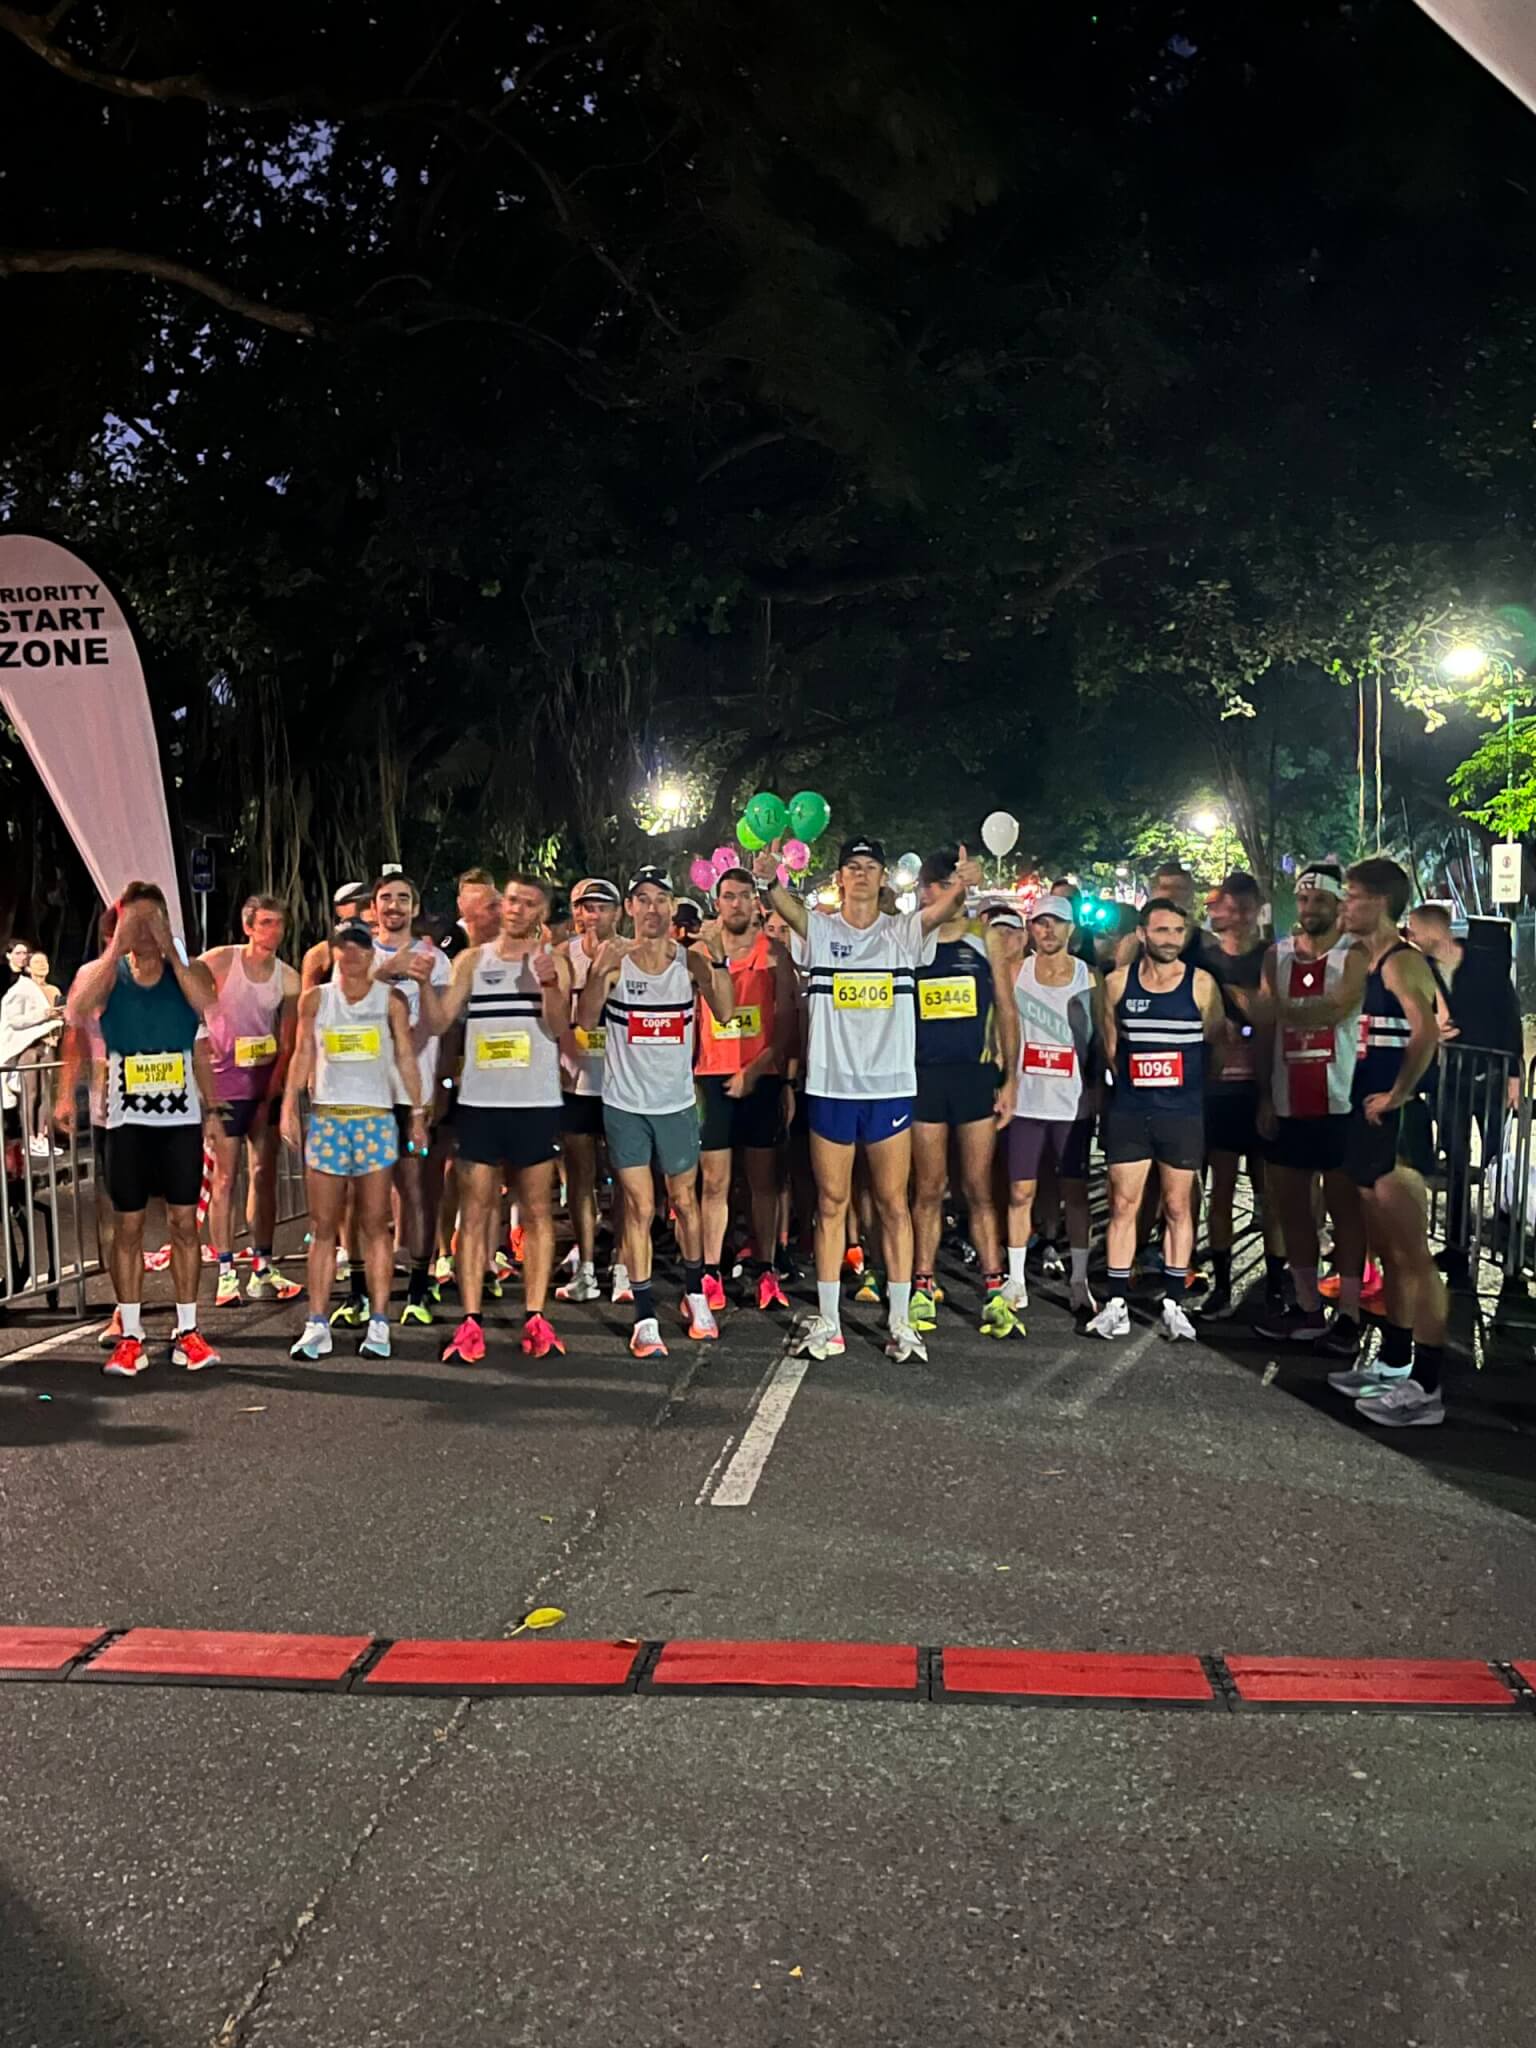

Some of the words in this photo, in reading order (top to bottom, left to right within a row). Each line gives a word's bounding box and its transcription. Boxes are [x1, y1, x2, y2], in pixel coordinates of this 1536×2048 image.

[0, 638, 109, 668] ZONE
[839, 986, 888, 1002] 63406
[925, 990, 971, 1006] 63446
[642, 1018, 671, 1028] COOPS
[136, 1063, 173, 1073] MARCUS
[1137, 1061, 1172, 1077] 1096
